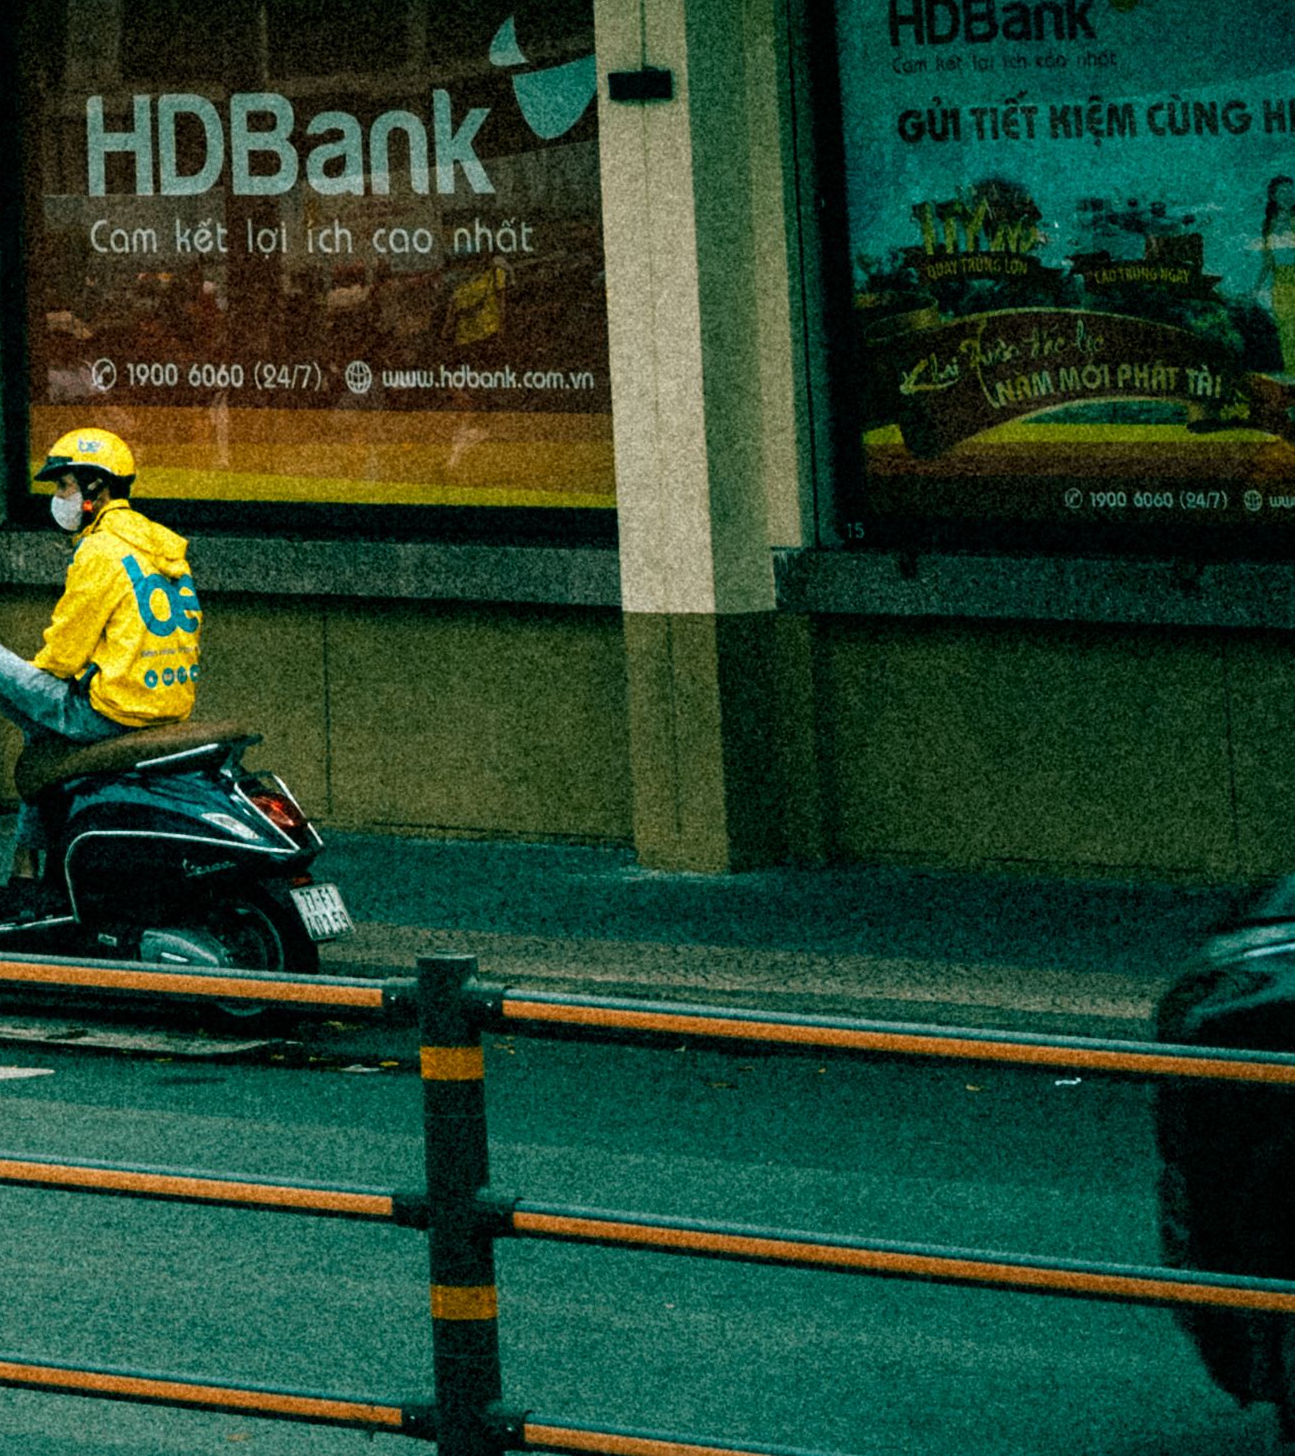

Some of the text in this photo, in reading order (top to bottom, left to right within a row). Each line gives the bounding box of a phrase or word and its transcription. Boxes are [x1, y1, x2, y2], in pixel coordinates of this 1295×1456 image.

[86, 89, 496, 197] HDBank
[1049, 95, 1138, 147] KIỆM
[1147, 93, 1252, 136] CÙNG
[89, 217, 535, 259] Cam kết lợi ích cao nhất
[126, 362, 596, 391] 1900 6060 (24/7) www.hdbank.com.vn
[1090, 491, 1128, 508] 1900
[1134, 491, 1175, 508] 6060
[1179, 489, 1229, 511] (24/7)
[122, 553, 201, 637] be
